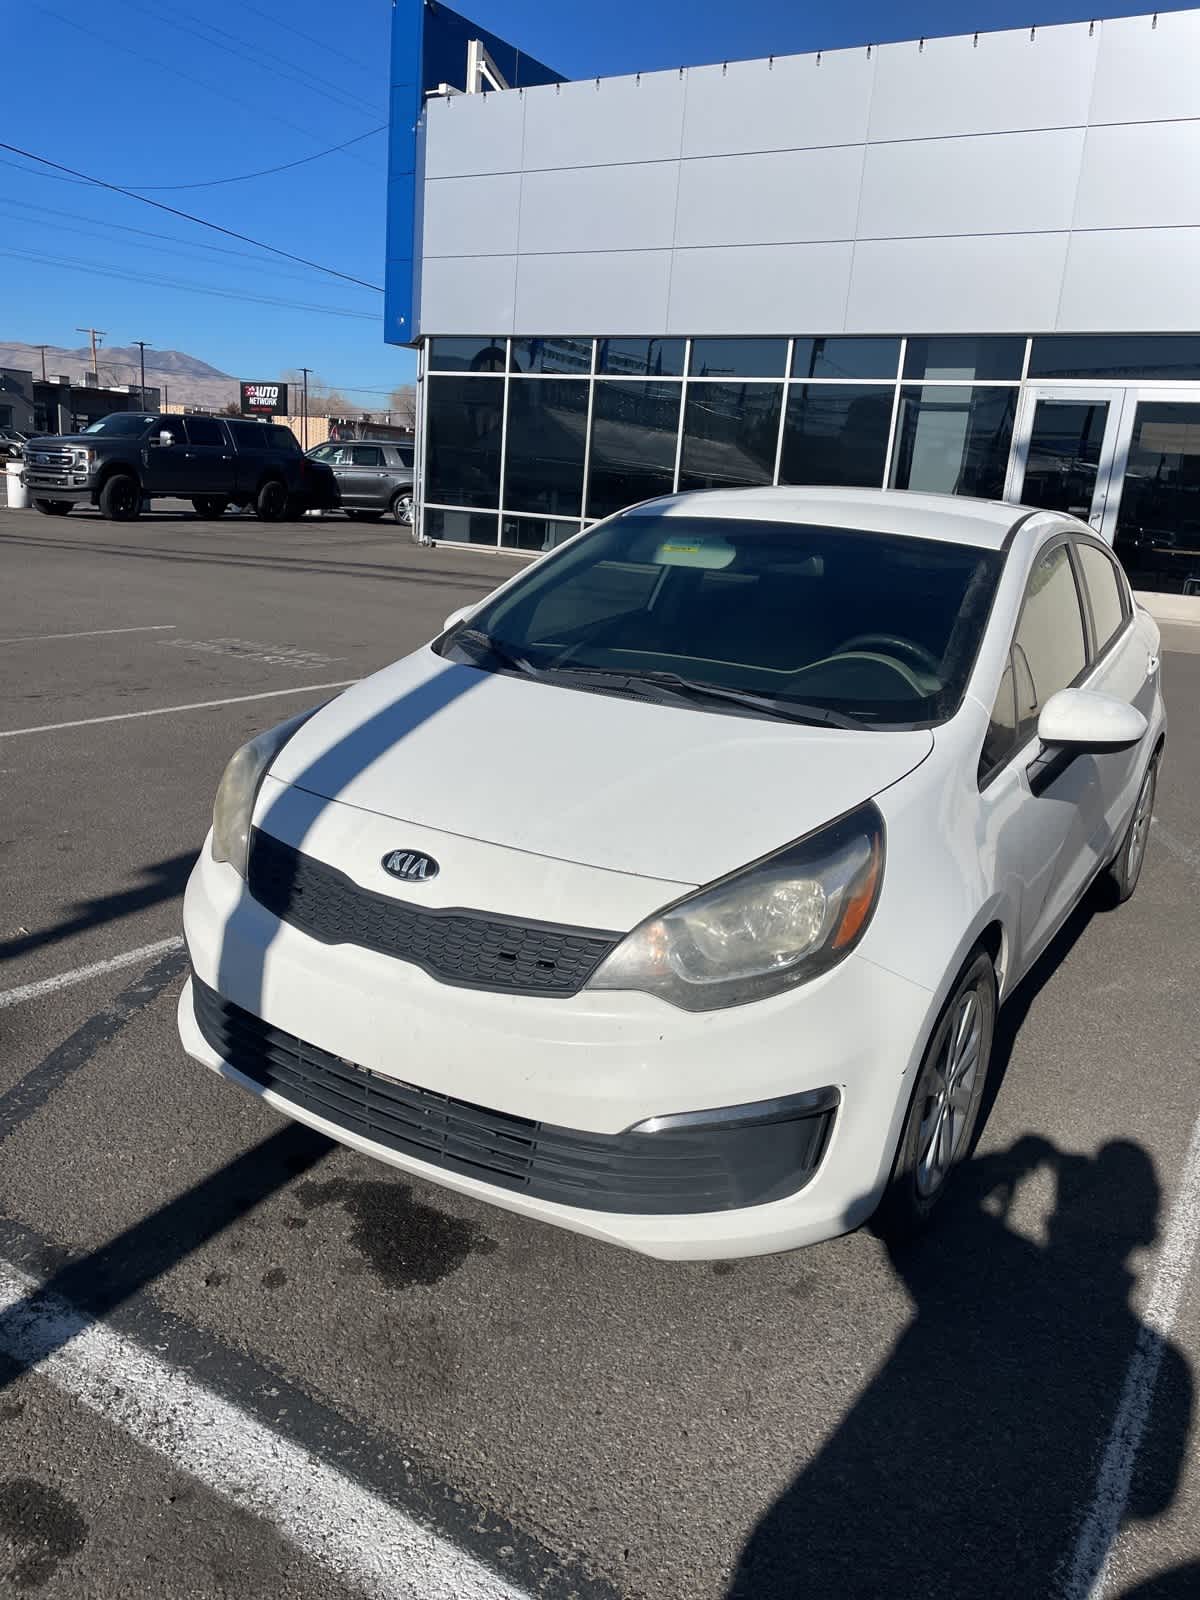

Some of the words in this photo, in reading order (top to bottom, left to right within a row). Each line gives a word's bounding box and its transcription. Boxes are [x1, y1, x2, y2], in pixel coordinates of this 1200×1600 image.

[254, 386, 278, 397] AUTO
[249, 397, 277, 406] NETWORK
[387, 852, 428, 878] KIA
